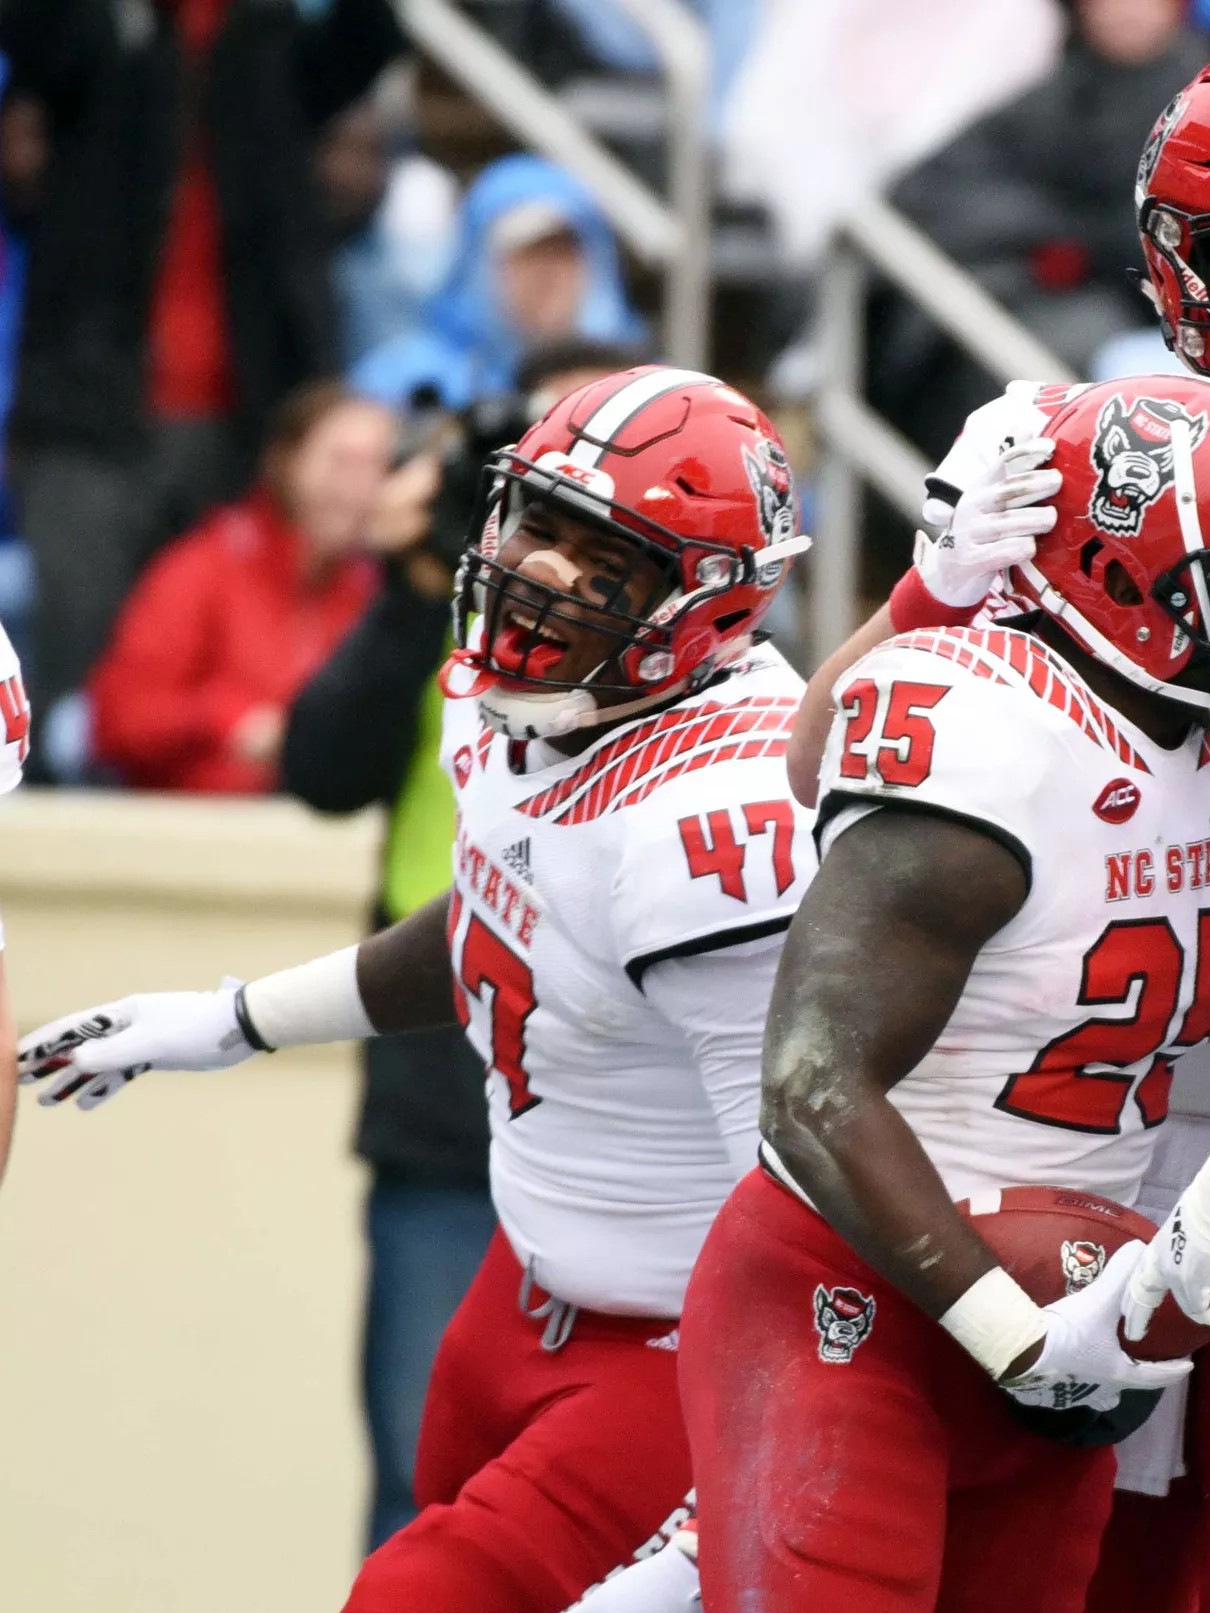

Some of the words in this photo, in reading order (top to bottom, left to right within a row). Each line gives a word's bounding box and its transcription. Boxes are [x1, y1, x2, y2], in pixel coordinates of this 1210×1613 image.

[838, 678, 952, 788] 25
[1101, 784, 1136, 810] ACC
[677, 798, 796, 904] 47
[1105, 847, 1155, 904] NC
[446, 890, 544, 1122] 7
